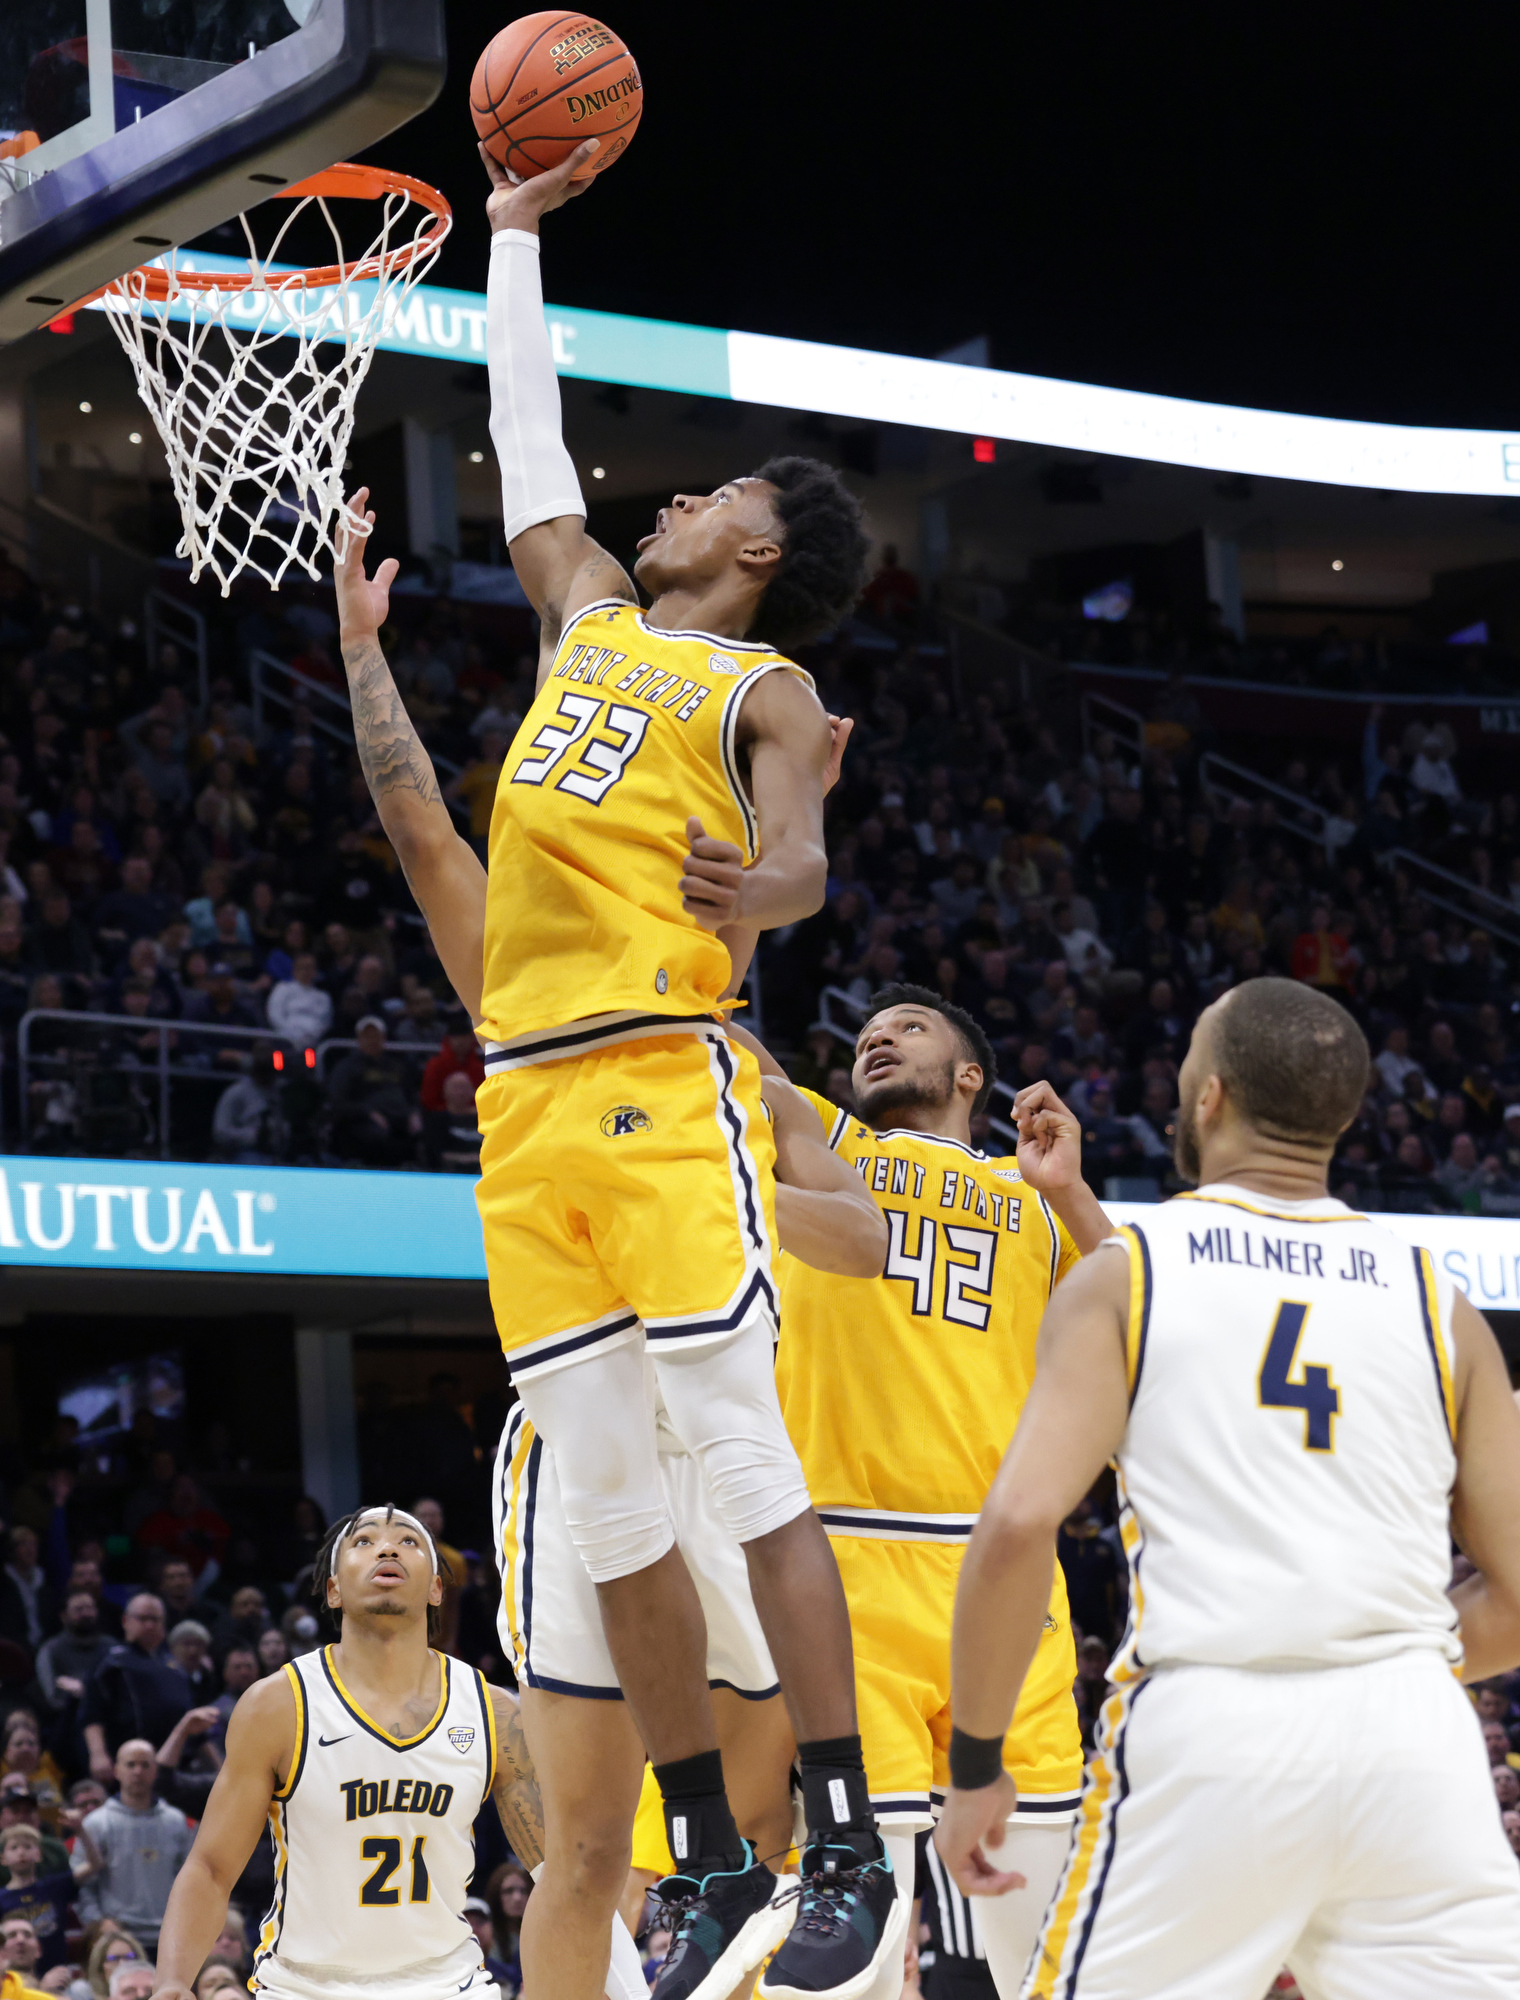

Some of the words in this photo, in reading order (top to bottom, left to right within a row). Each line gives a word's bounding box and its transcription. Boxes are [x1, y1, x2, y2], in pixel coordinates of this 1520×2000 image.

[553, 31, 615, 76] EGACY
[376, 289, 577, 367] MUTL
[554, 644, 628, 685] KENT
[616, 662, 712, 723] STATE
[510, 691, 654, 807] 33
[855, 1156, 926, 1199] KENT
[940, 1171, 1022, 1233] STATE
[882, 1208, 999, 1332] 42
[1187, 1227, 1325, 1279] MILLNER
[1339, 1247, 1389, 1288] JR.
[1255, 1298, 1342, 1455] 4
[340, 1777, 454, 1822] TOLEDO
[358, 1835, 431, 1908] 21
